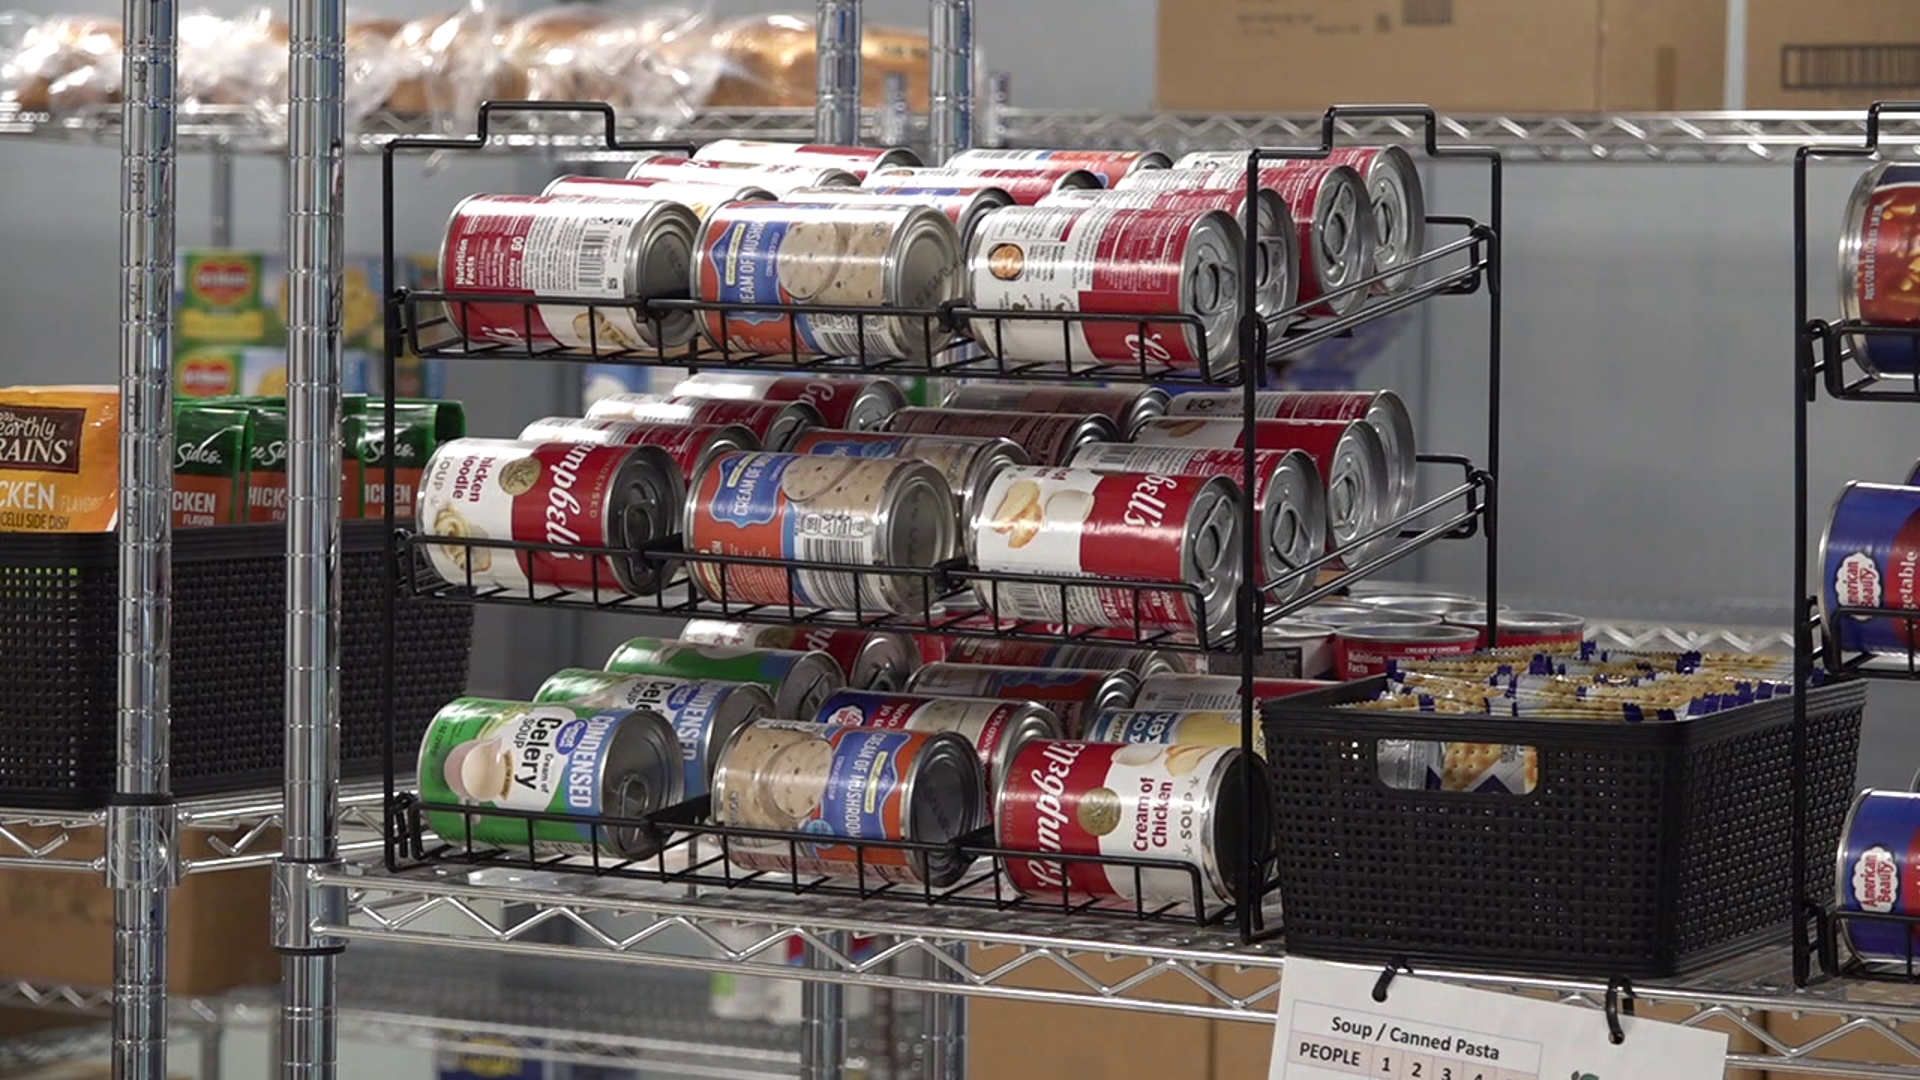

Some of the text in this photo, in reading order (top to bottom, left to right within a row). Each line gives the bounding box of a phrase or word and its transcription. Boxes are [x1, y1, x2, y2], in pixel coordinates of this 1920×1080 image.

[455, 238, 469, 286] Nutrition
[511, 236, 525, 252] 60
[465, 256, 476, 287] Facts
[507, 257, 517, 288] Calories
[740, 259, 755, 274] OF
[452, 455, 479, 500] oodle
[469, 456, 497, 503] hicken
[734, 466, 761, 516] CREAM OF
[26, 512, 47, 529] SIDE
[48, 514, 70, 530] DISH
[545, 442, 596, 562] ampbell's
[1843, 561, 1860, 606] merican
[1348, 651, 1384, 664] Nutrition
[1348, 662, 1369, 674] Facts
[513, 718, 535, 749] SOUP
[514, 717, 562, 790] Celery
[857, 732, 887, 758] CREAM
[541, 753, 554, 795] Cream of
[569, 715, 616, 808] CONDENSED
[853, 759, 869, 772] OF
[844, 774, 866, 838] MUSHROOM
[1133, 778, 1156, 852] Cream of
[1152, 782, 1173, 848] Chicken
[1180, 793, 1196, 840] SOUP
[1860, 854, 1878, 907] American
[1878, 860, 1895, 904] Beauty
[1331, 1016, 1500, 1060] Soup / Canned Pasta
[1299, 1042, 1452, 1080] PEOPLE 1 2 3
